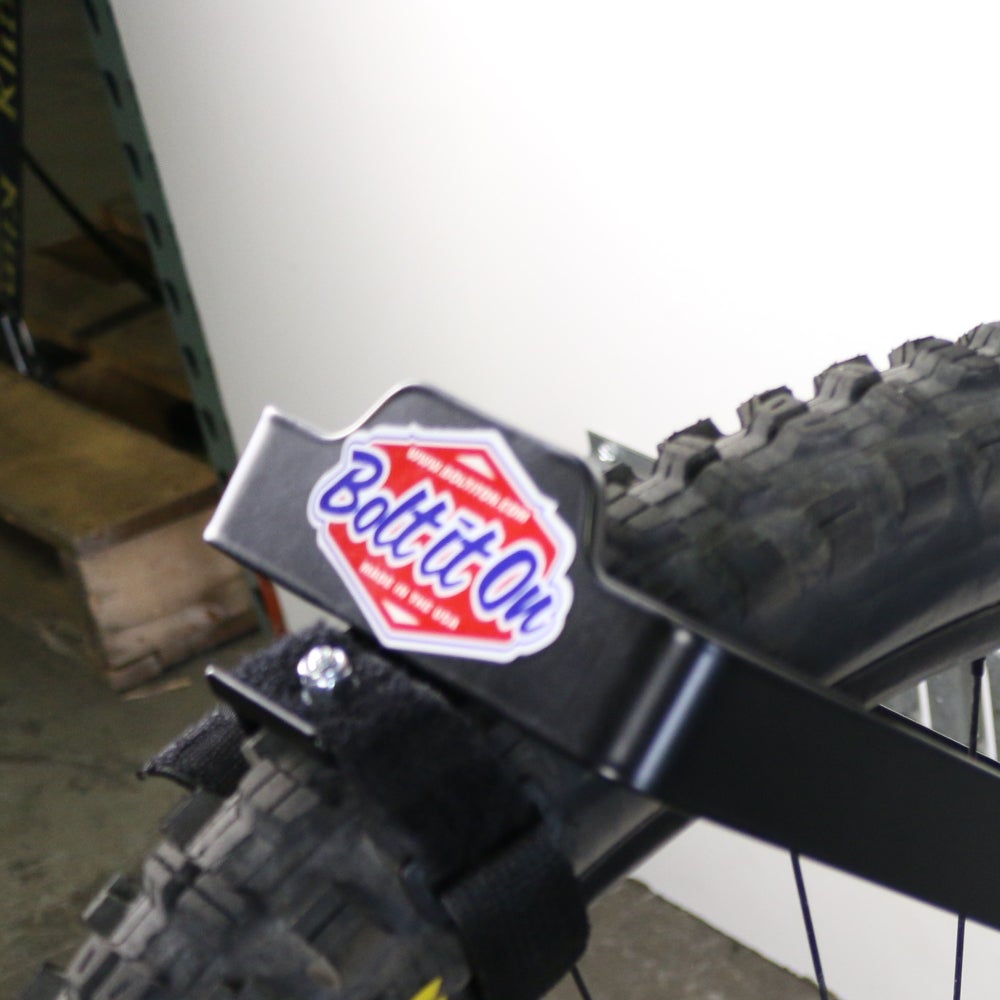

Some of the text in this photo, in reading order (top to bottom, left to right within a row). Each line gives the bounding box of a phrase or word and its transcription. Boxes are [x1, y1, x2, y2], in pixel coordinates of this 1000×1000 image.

[319, 450, 552, 634] Bolt it On
[360, 562, 462, 631] MADE IN THE USA
